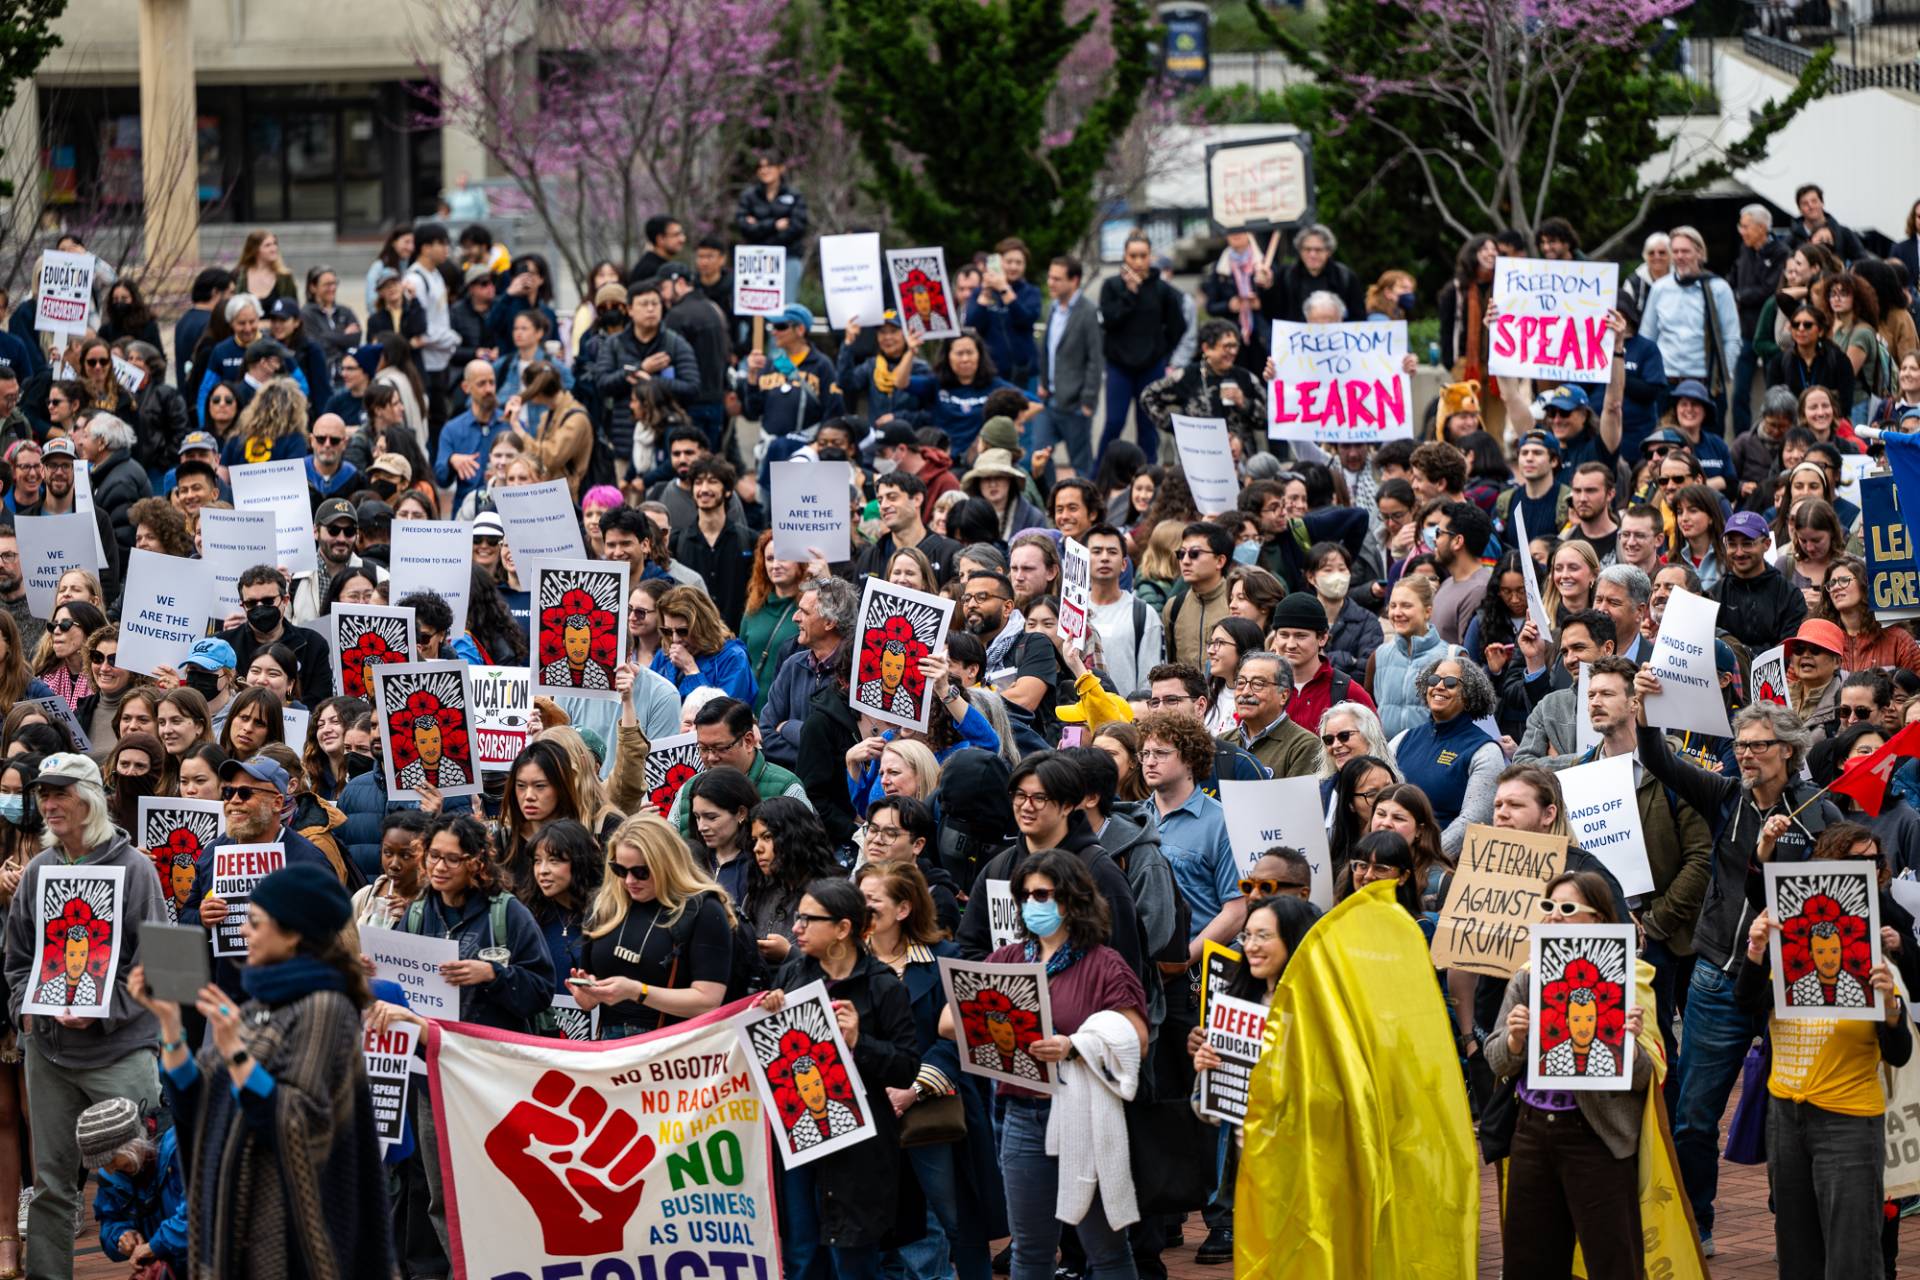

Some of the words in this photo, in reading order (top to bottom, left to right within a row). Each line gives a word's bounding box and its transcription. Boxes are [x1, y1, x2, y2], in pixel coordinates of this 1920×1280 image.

[1507, 269, 1601, 296] FREEDOM
[1536, 294, 1557, 311] TO
[1289, 330, 1392, 355] FREEDOM
[1494, 313, 1609, 370] SPEAK
[1316, 355, 1351, 374] TO
[1275, 374, 1406, 430] LEARN
[538, 487, 557, 495] SPEAK
[801, 495, 818, 503] WE
[209, 514, 236, 522] FREEDOM
[545, 514, 565, 522] TEACH
[789, 509, 809, 518] ARE
[812, 509, 833, 518] THE
[779, 521, 842, 531] UNIVERSITY
[47, 551, 64, 560] WE
[554, 544, 574, 552] LEARN
[37, 566, 58, 575] ARE
[540, 571, 577, 610] RELEASE
[578, 571, 619, 613] MAHMOUD
[1873, 571, 1920, 608] GRE
[156, 595, 175, 607] WE
[139, 609, 163, 623] ARE
[165, 614, 189, 627] THE
[866, 594, 902, 629] RELEASE
[902, 600, 940, 647] MAHMOUD
[127, 622, 196, 643] UNIVERSITY
[193, 641, 213, 654] Cal
[1661, 635, 1685, 652] HANDS
[1686, 643, 1703, 657] OFF
[1668, 655, 1688, 669] OUR
[1651, 666, 1710, 689] COMMUNITY
[386, 673, 419, 715] RELEASE
[420, 672, 465, 709] MAHMOUD
[471, 679, 529, 709] UCATION
[486, 709, 499, 717] NOT
[478, 732, 523, 760] SORSHIP
[1602, 798, 1623, 813] OFF
[147, 809, 183, 850] RELEASE
[1260, 829, 1282, 841] WE
[1583, 819, 1607, 833] OUR
[1580, 829, 1631, 851] MMUNITY
[217, 851, 283, 877] DEFEND
[1471, 838, 1558, 883] VETERANS
[44, 878, 76, 923] RELEASE
[76, 879, 113, 922] MAHMOUD
[1453, 883, 1541, 920] AGAINST
[1778, 876, 1820, 921] RELEASE
[1821, 876, 1869, 918] MAHMOUD
[229, 937, 243, 947] FOR
[1450, 916, 1530, 962] TRUMP
[374, 952, 419, 970] HANDS
[1541, 938, 1582, 985] RELEASE
[1582, 938, 1626, 984] MAHMOUD
[398, 972, 424, 987] OUR
[403, 990, 444, 1008] DENTS
[790, 1002, 834, 1041] MAHMOUD
[364, 1029, 410, 1055] END
[368, 1056, 408, 1075] TION!
[610, 1069, 642, 1086] NO
[649, 1051, 730, 1082] BIGOTRY
[373, 1084, 401, 1096] SPEAK
[641, 1090, 670, 1114] NO
[677, 1071, 750, 1113] RACISM
[374, 1109, 397, 1121] EARN
[659, 1119, 684, 1144] NO
[665, 1129, 745, 1192] NO
[661, 1192, 756, 1220] BUSINESS
[650, 1223, 679, 1245] AS
[688, 1221, 754, 1246] USUAL
